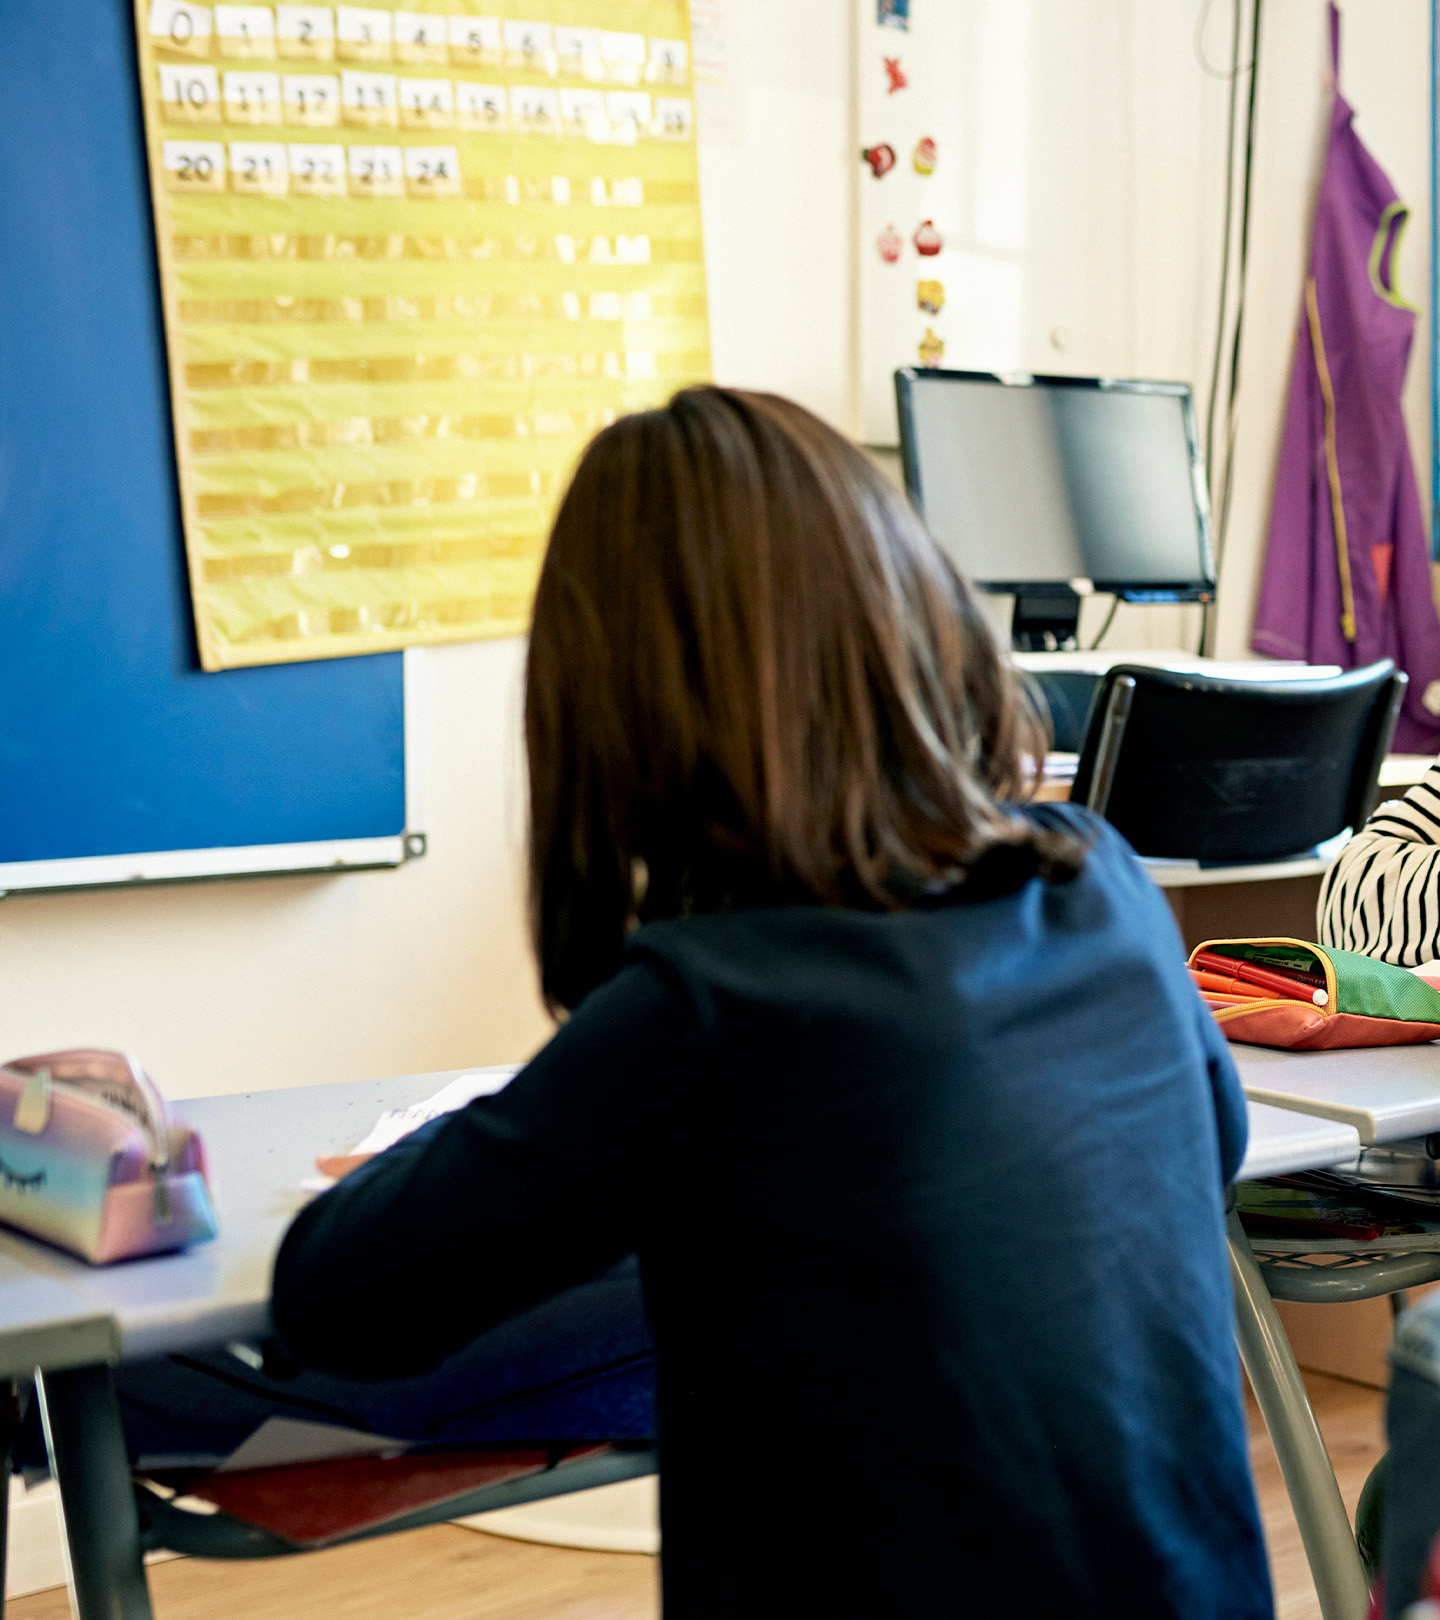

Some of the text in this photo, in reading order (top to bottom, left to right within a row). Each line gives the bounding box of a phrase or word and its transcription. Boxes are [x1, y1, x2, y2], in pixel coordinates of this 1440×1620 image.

[169, 10, 193, 46] 0
[239, 21, 251, 46] 1
[298, 20, 313, 46] 2
[355, 23, 371, 47] 3
[411, 28, 426, 47] 4
[467, 30, 482, 56] 5
[520, 32, 536, 60] 6
[173, 79, 208, 110] 10
[237, 85, 267, 112] 11
[297, 88, 328, 115] 12
[354, 86, 386, 112] 13
[413, 92, 442, 118] 14
[468, 96, 498, 123] 15
[521, 99, 551, 125] 16
[176, 154, 449, 186] 20 21 22 23 24
